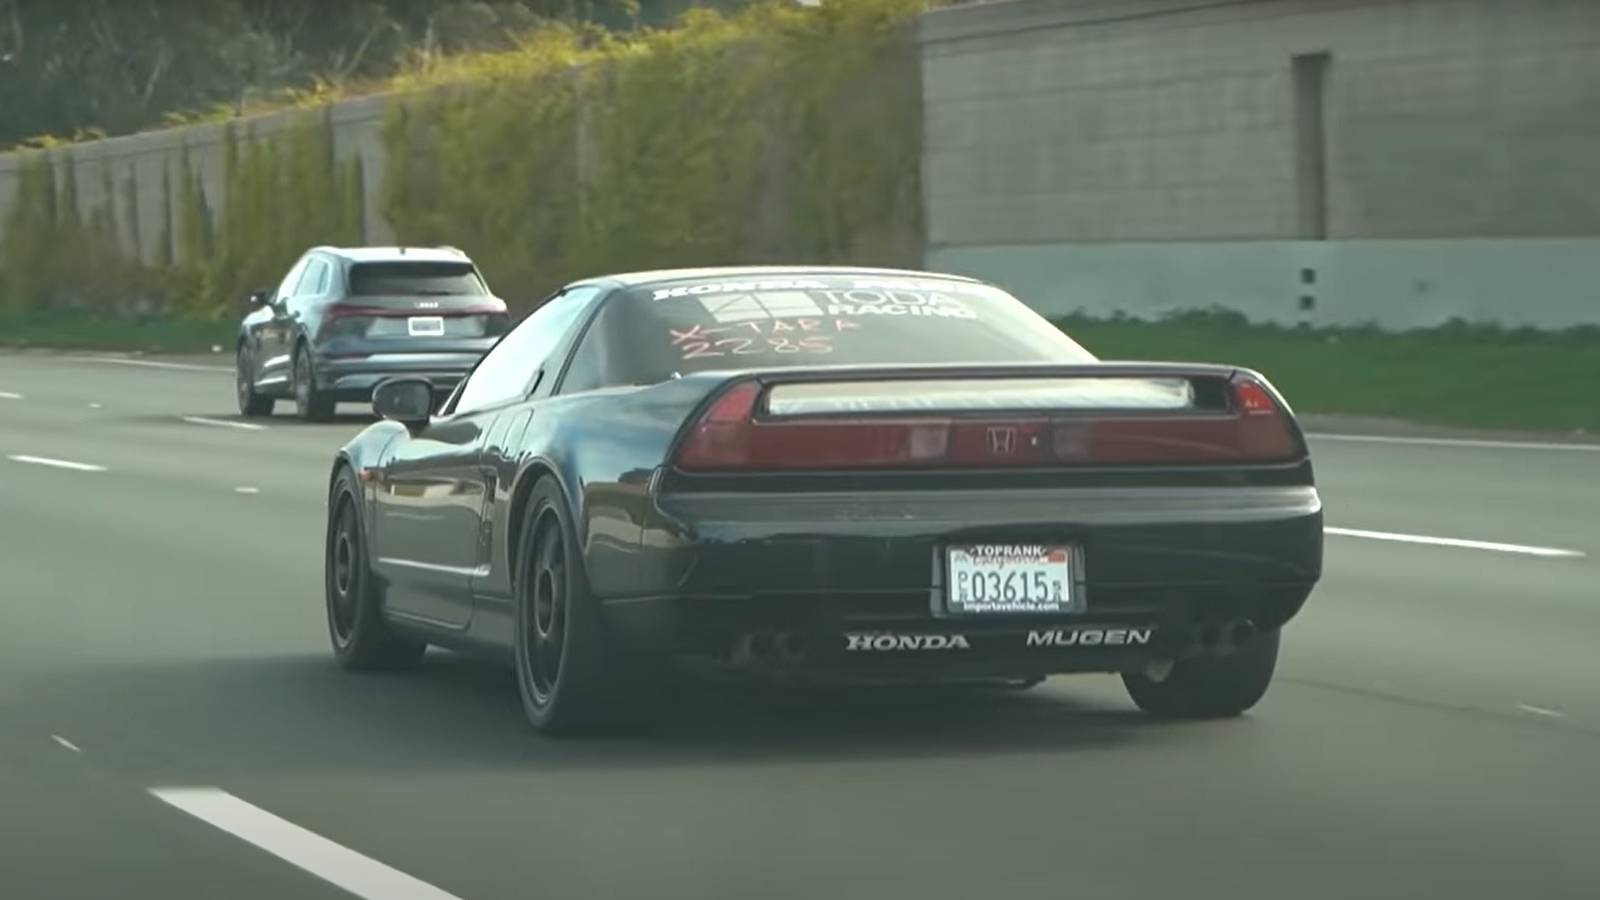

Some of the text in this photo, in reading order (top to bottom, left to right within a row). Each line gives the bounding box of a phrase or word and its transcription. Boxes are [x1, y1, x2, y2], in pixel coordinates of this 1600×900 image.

[812, 289, 966, 306] TODA
[827, 303, 977, 319] RACING
[682, 336, 833, 360] 2285
[976, 545, 1043, 556] TOPRANK
[972, 571, 1048, 602] 03615
[847, 629, 1151, 650] HONDA MUGEN
